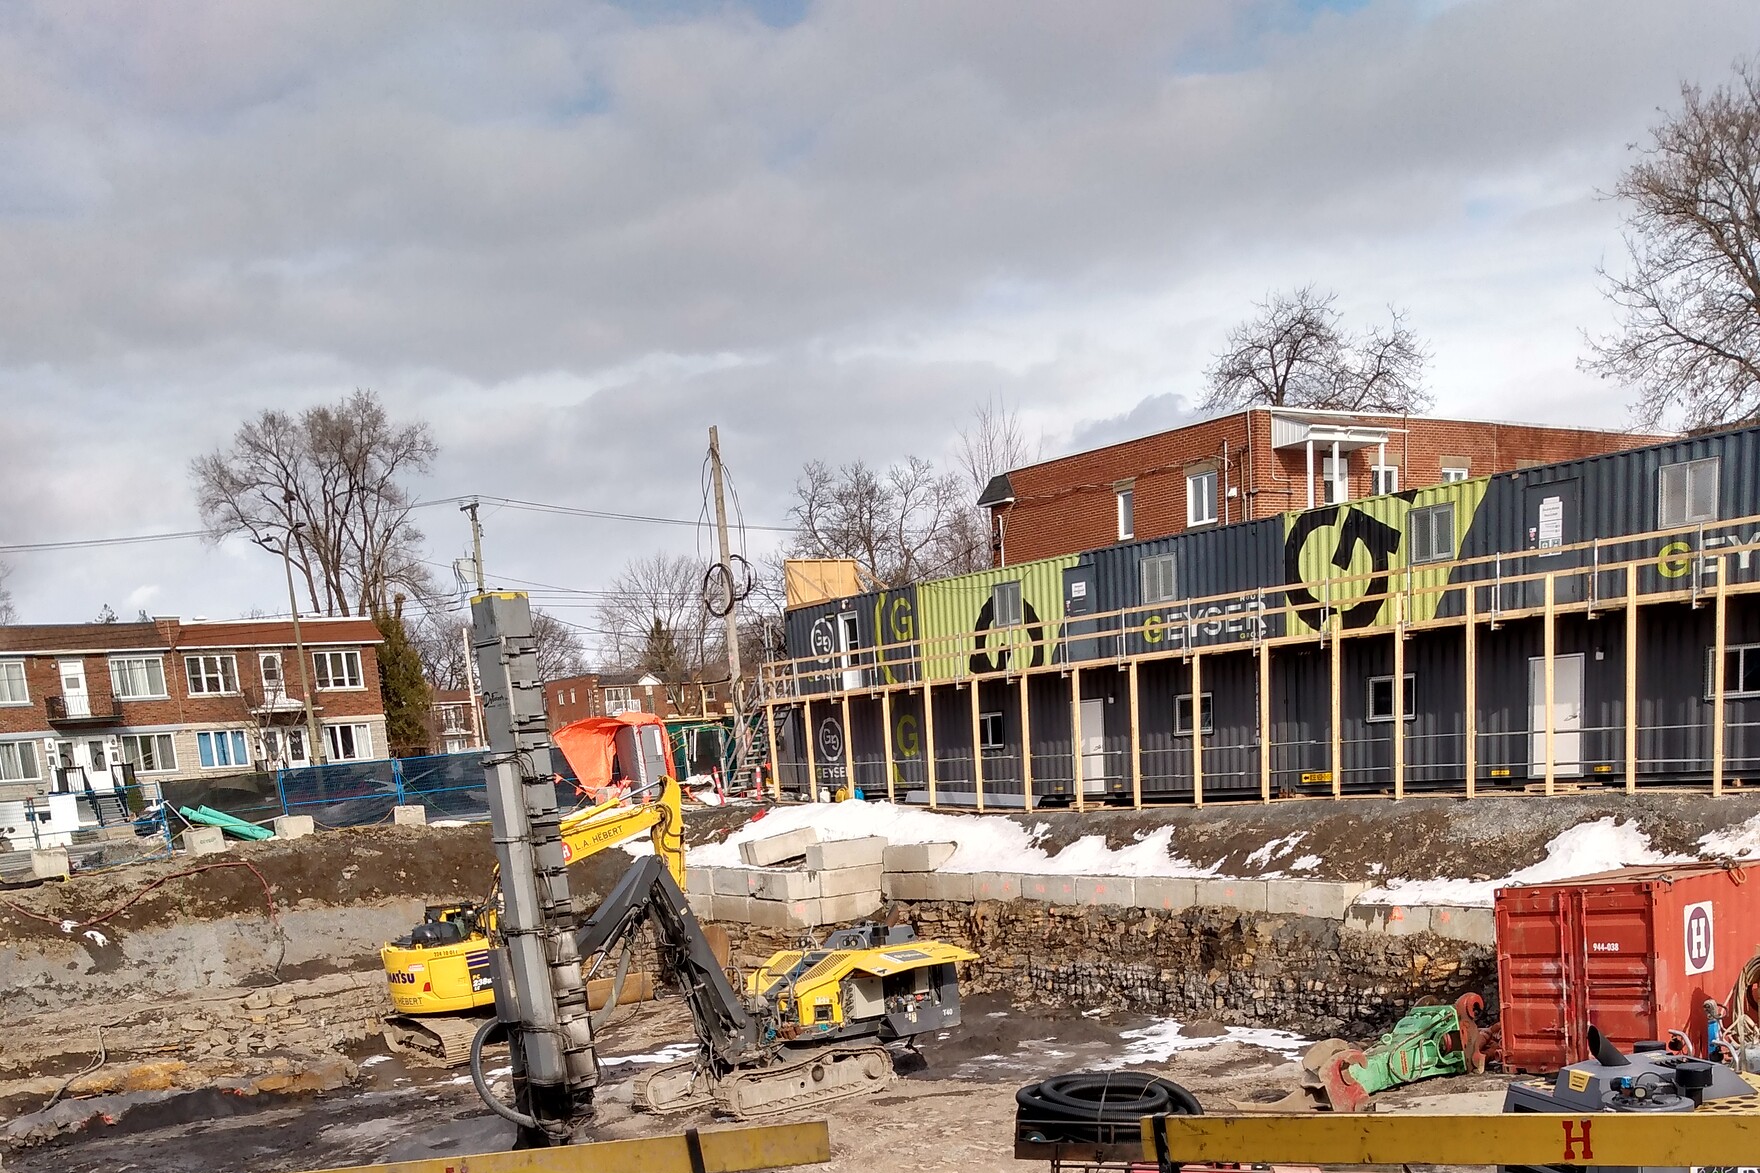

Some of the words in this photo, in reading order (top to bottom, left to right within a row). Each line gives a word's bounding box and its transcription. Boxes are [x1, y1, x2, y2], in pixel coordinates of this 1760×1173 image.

[890, 597, 914, 641] G
[1143, 601, 1267, 643] GEYSER
[897, 714, 919, 757] G
[816, 766, 849, 779] GEYSE
[1691, 917, 1707, 959] H
[1562, 1120, 1594, 1160] H
